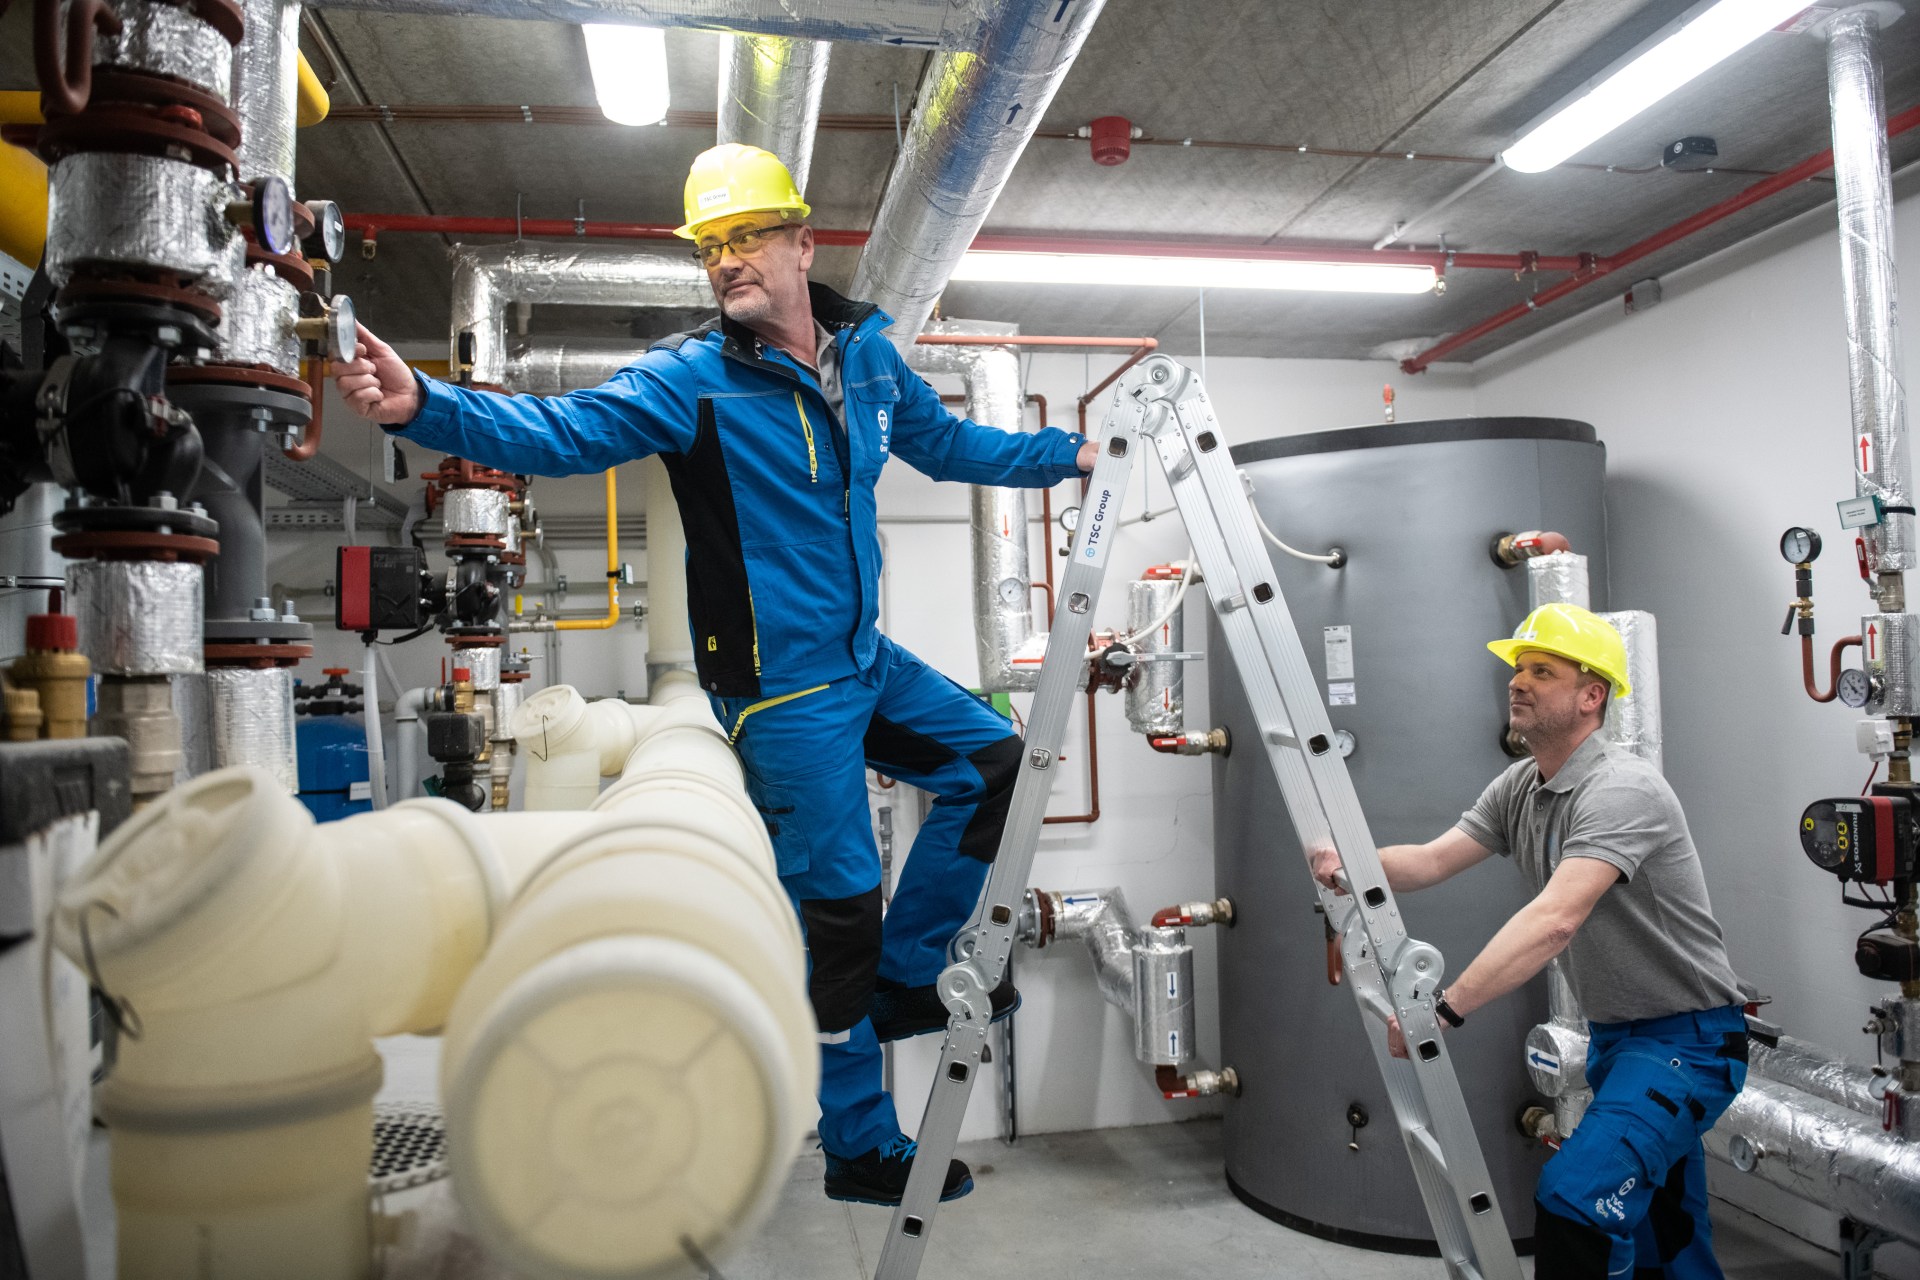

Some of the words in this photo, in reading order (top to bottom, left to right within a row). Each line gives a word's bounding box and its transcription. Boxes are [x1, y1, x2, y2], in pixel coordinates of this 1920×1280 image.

[1094, 489, 1112, 522] Group
[1088, 523, 1102, 545] TSC
[1606, 1199, 1626, 1221] Group
[1611, 1192, 1624, 1209] TSC
